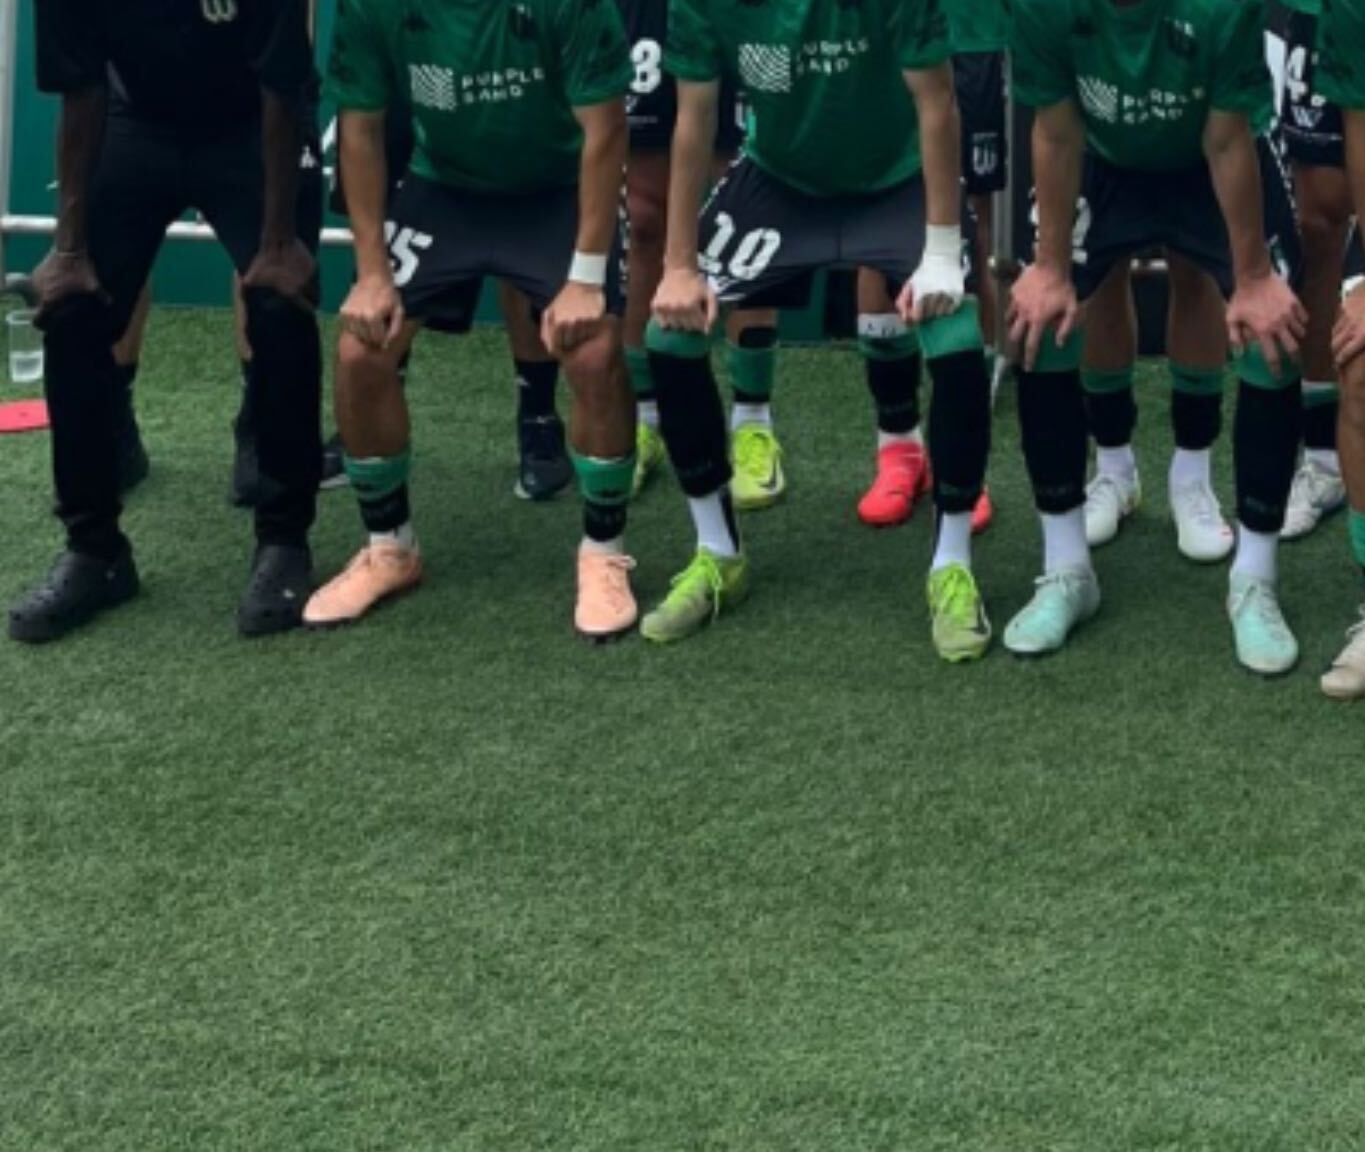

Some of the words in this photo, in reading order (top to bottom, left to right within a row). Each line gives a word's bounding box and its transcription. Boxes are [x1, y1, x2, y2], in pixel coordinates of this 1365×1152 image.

[797, 37, 869, 56] URPLE
[462, 67, 545, 89] PURPLE
[463, 85, 523, 103] SAND
[698, 212, 781, 280] 10
